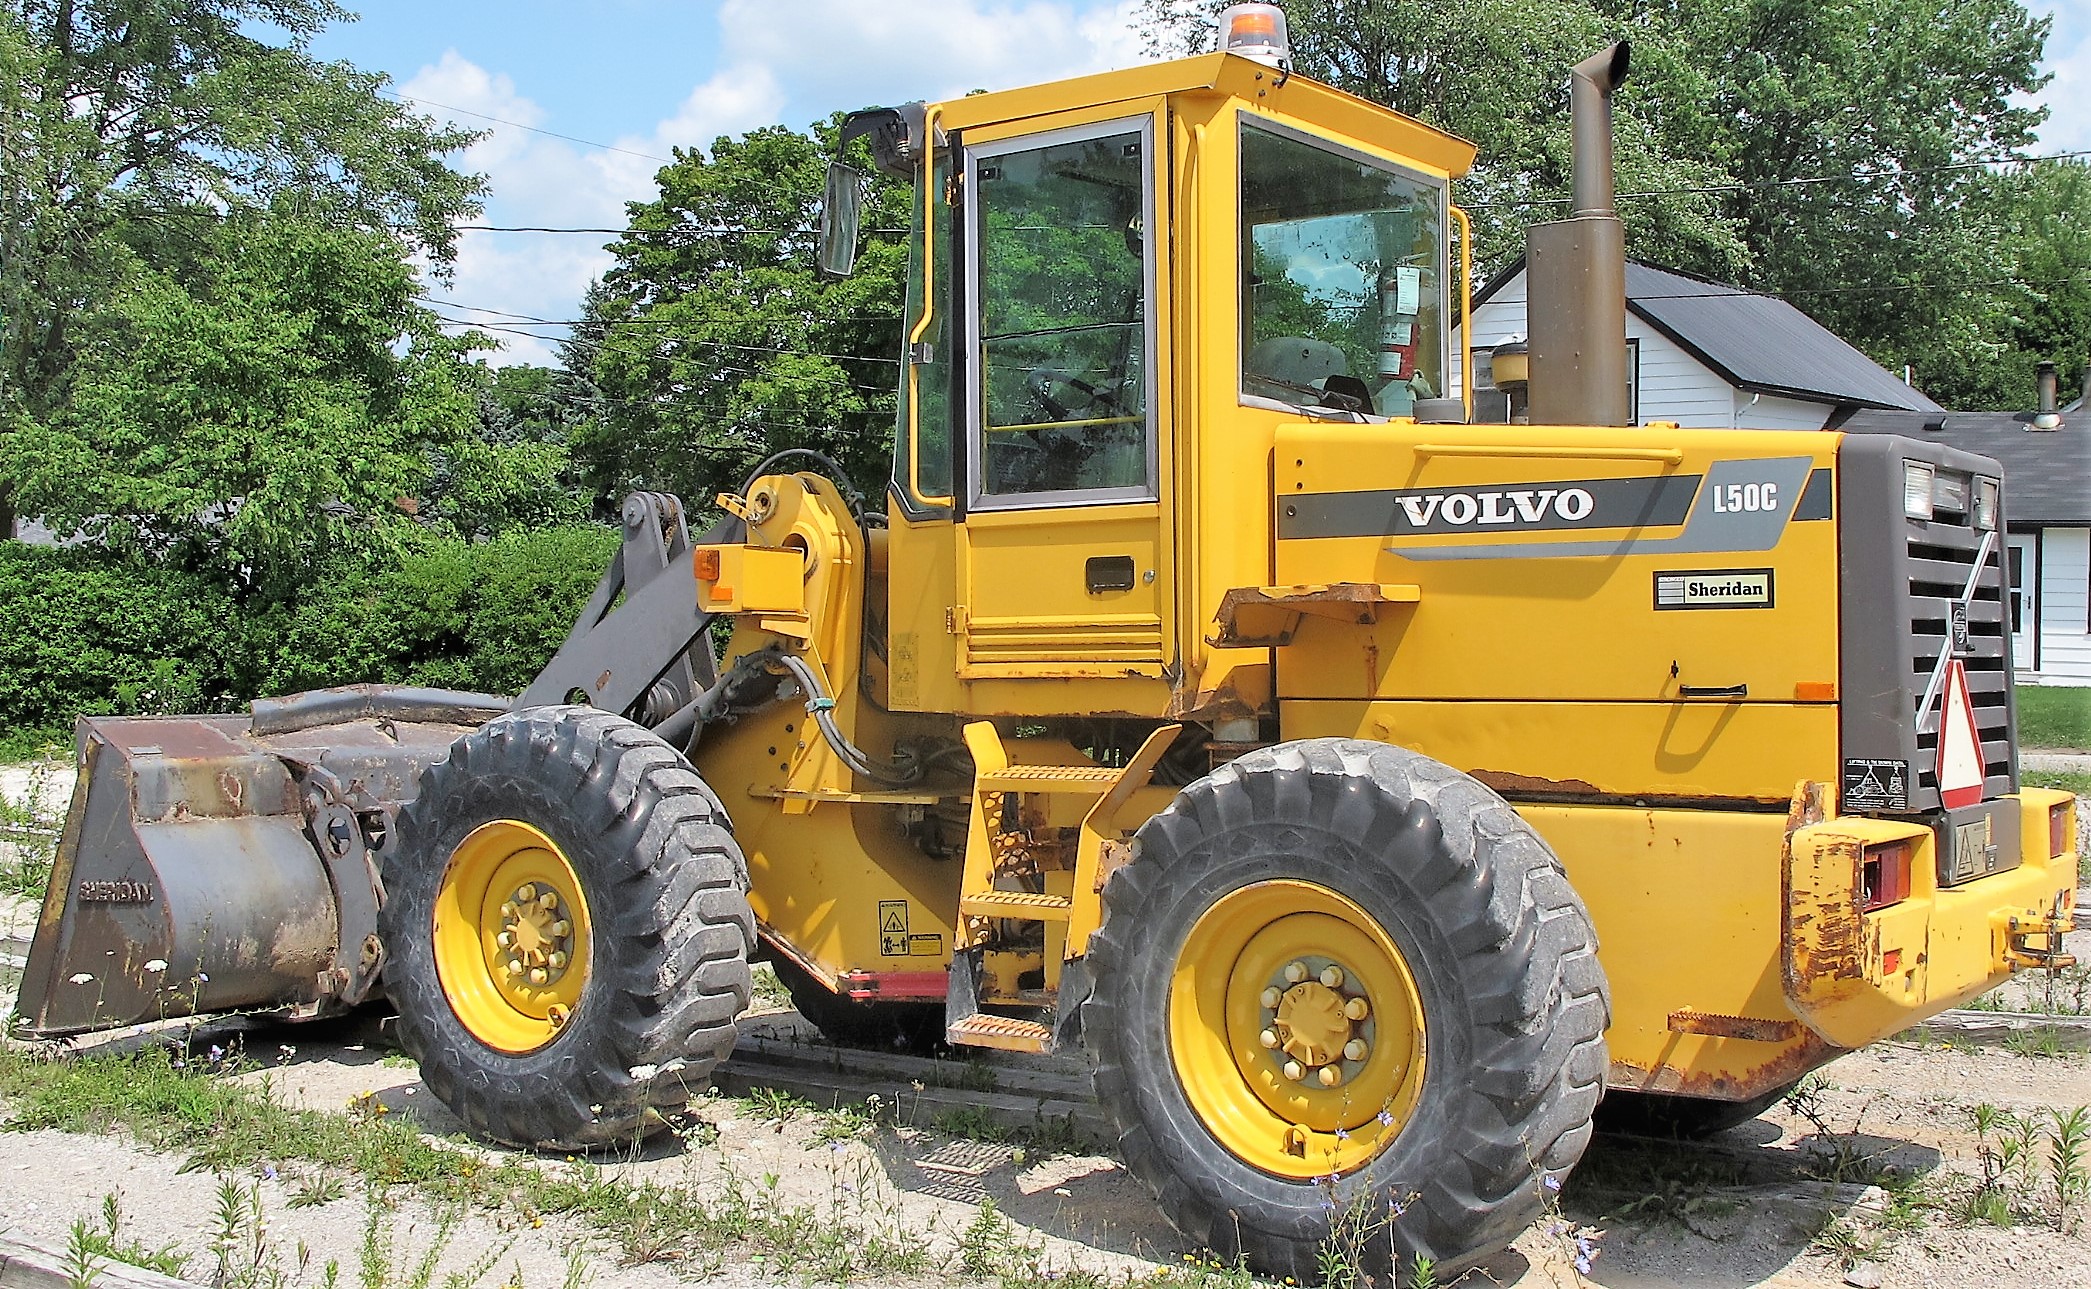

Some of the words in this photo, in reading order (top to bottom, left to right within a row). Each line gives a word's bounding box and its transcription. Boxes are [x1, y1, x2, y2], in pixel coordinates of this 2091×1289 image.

[1395, 488, 1594, 527] VOLVO
[1713, 483, 1777, 513] L50C
[1688, 582, 1763, 597] Sheridan
[79, 881, 154, 901] SHERIDAN
